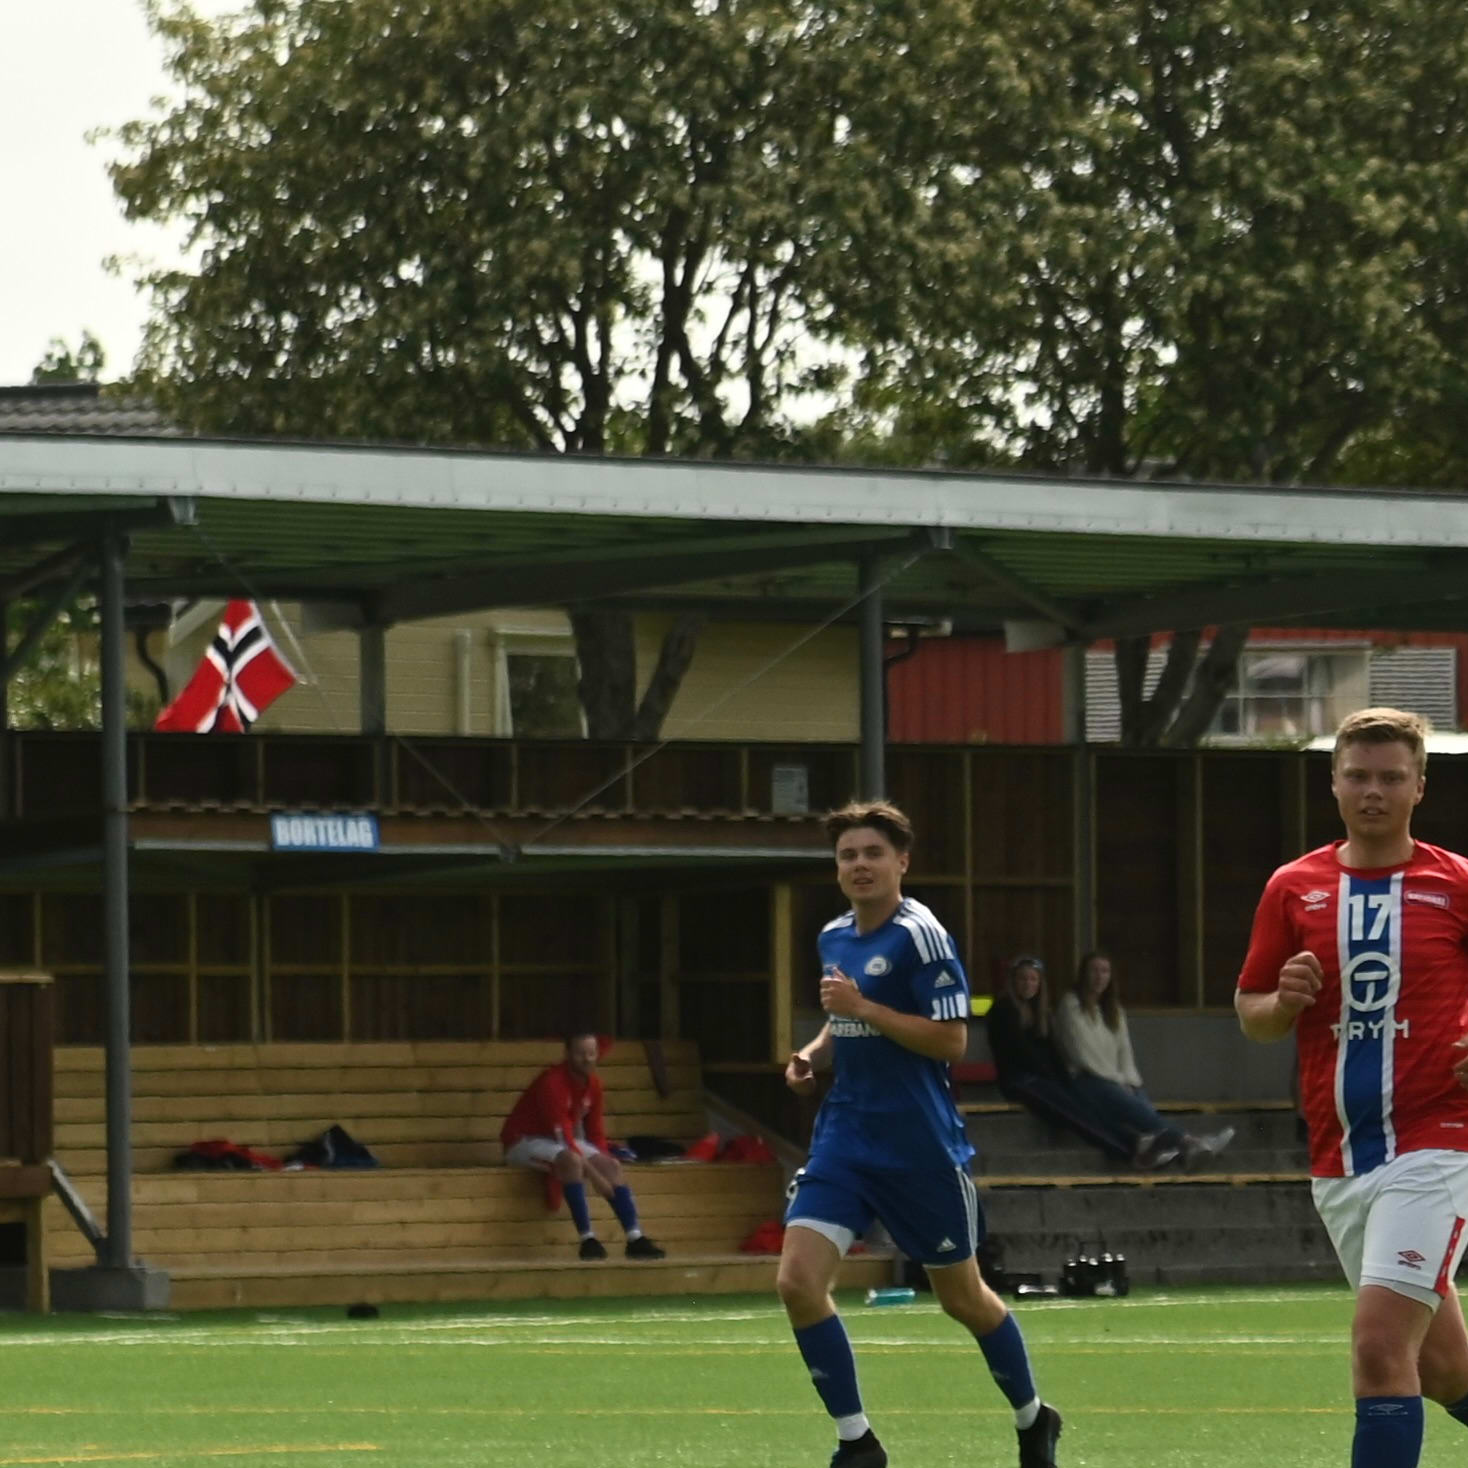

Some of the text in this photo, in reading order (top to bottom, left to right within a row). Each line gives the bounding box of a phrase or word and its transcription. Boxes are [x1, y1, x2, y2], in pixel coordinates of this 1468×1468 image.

[275, 817, 374, 848] BORTELAG
[1349, 893, 1393, 941] 17
[1329, 1018, 1410, 1040] TRYM
